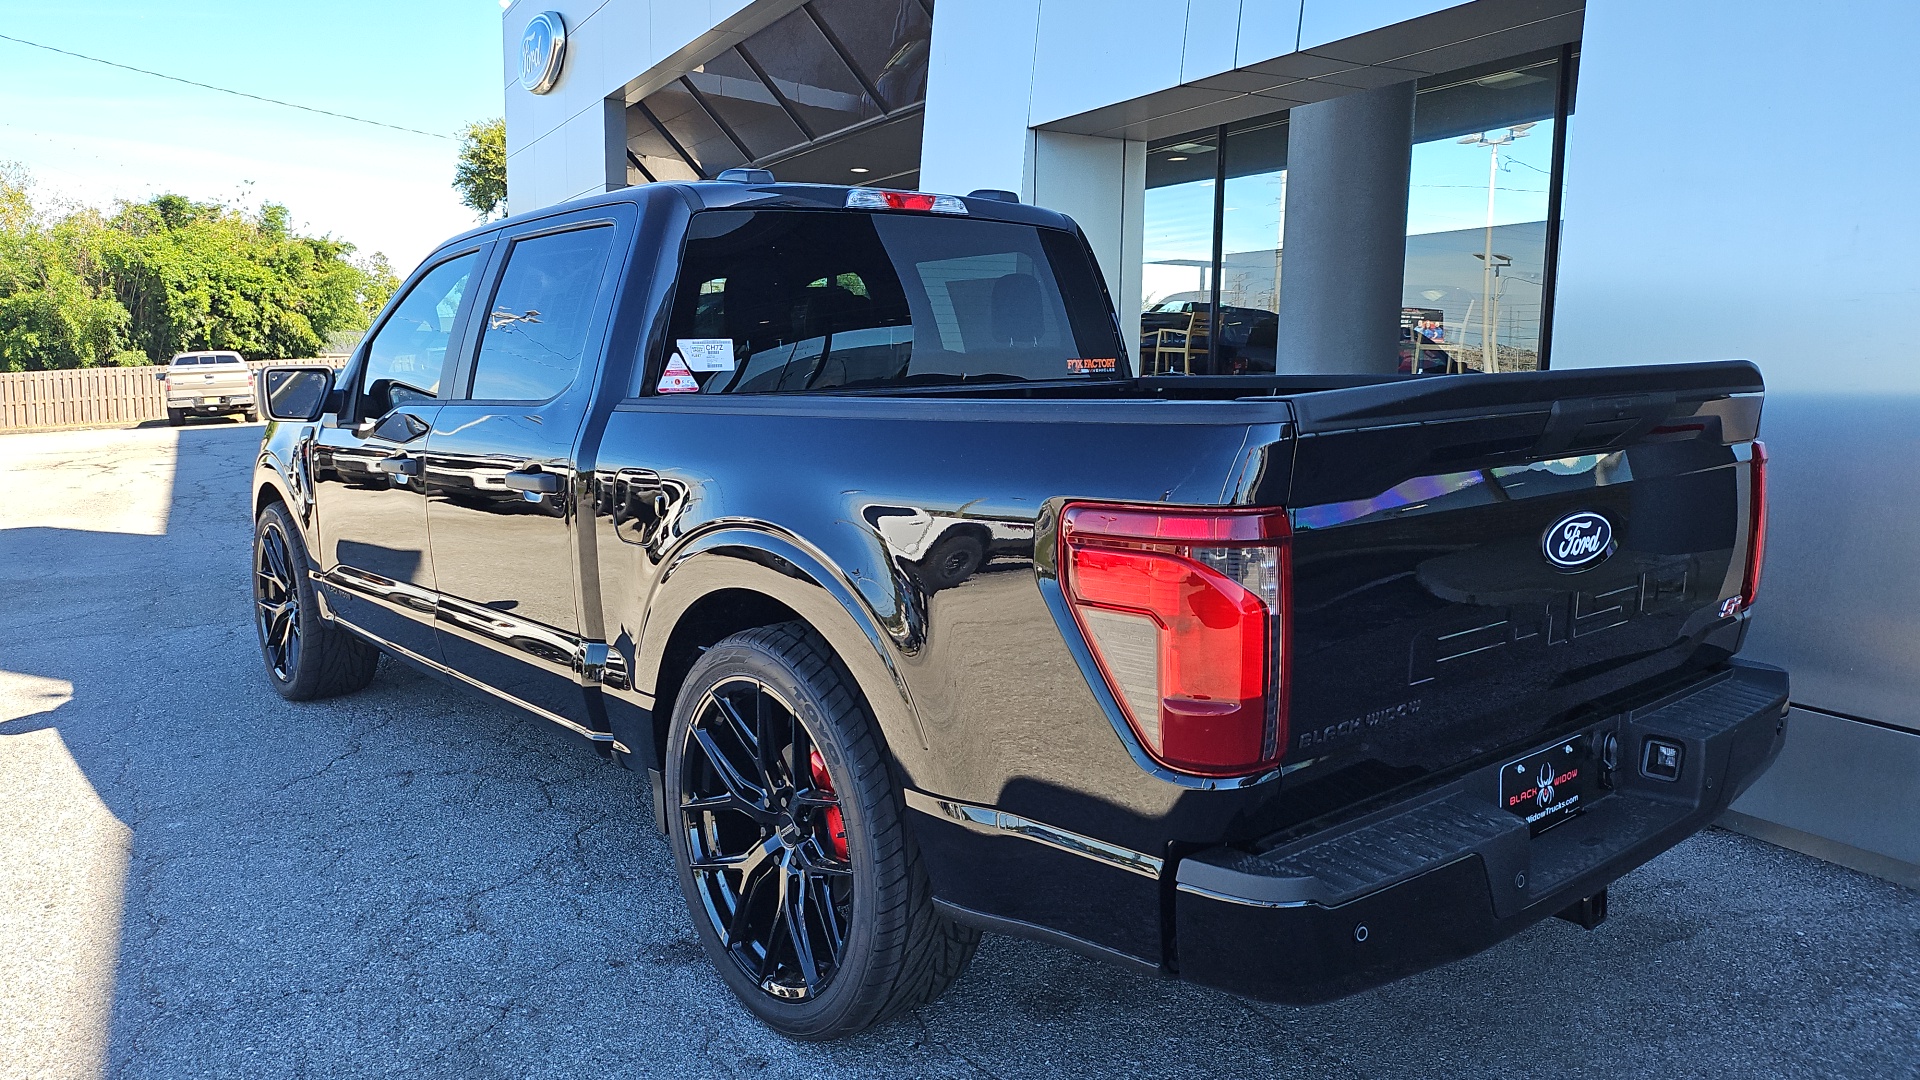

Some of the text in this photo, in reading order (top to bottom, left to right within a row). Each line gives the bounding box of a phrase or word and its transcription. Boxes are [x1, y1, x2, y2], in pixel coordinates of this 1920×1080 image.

[522, 31, 542, 78] Ford
[1084, 358, 1116, 368] FACTORY
[1558, 520, 1602, 558] Ford
[793, 685, 841, 766] TOYO
[1299, 718, 1360, 748] BLACK
[1509, 768, 1578, 806] BLACK WIDOW
[1525, 794, 1579, 824] WidowTrucks.com
